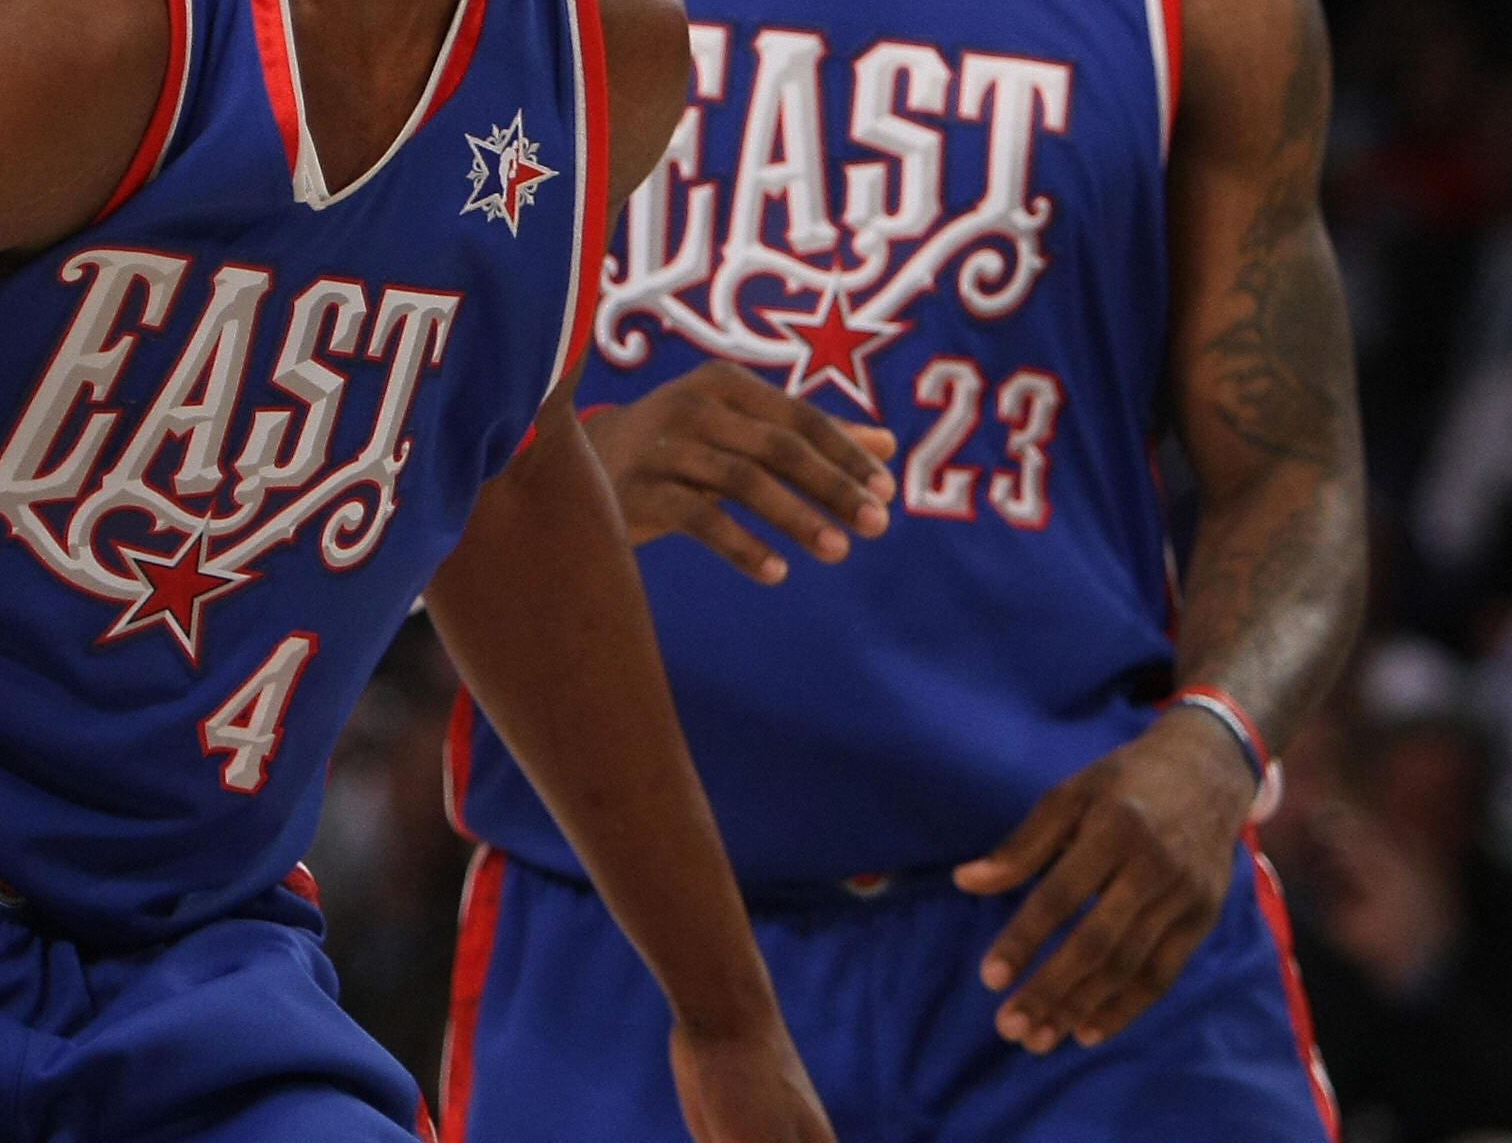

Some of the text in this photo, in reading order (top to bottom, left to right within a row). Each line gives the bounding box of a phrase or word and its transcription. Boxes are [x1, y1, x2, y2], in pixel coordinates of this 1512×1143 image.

[596, 22, 1070, 362] EAST
[903, 356, 1063, 530] 23
[197, 631, 319, 794] 4
